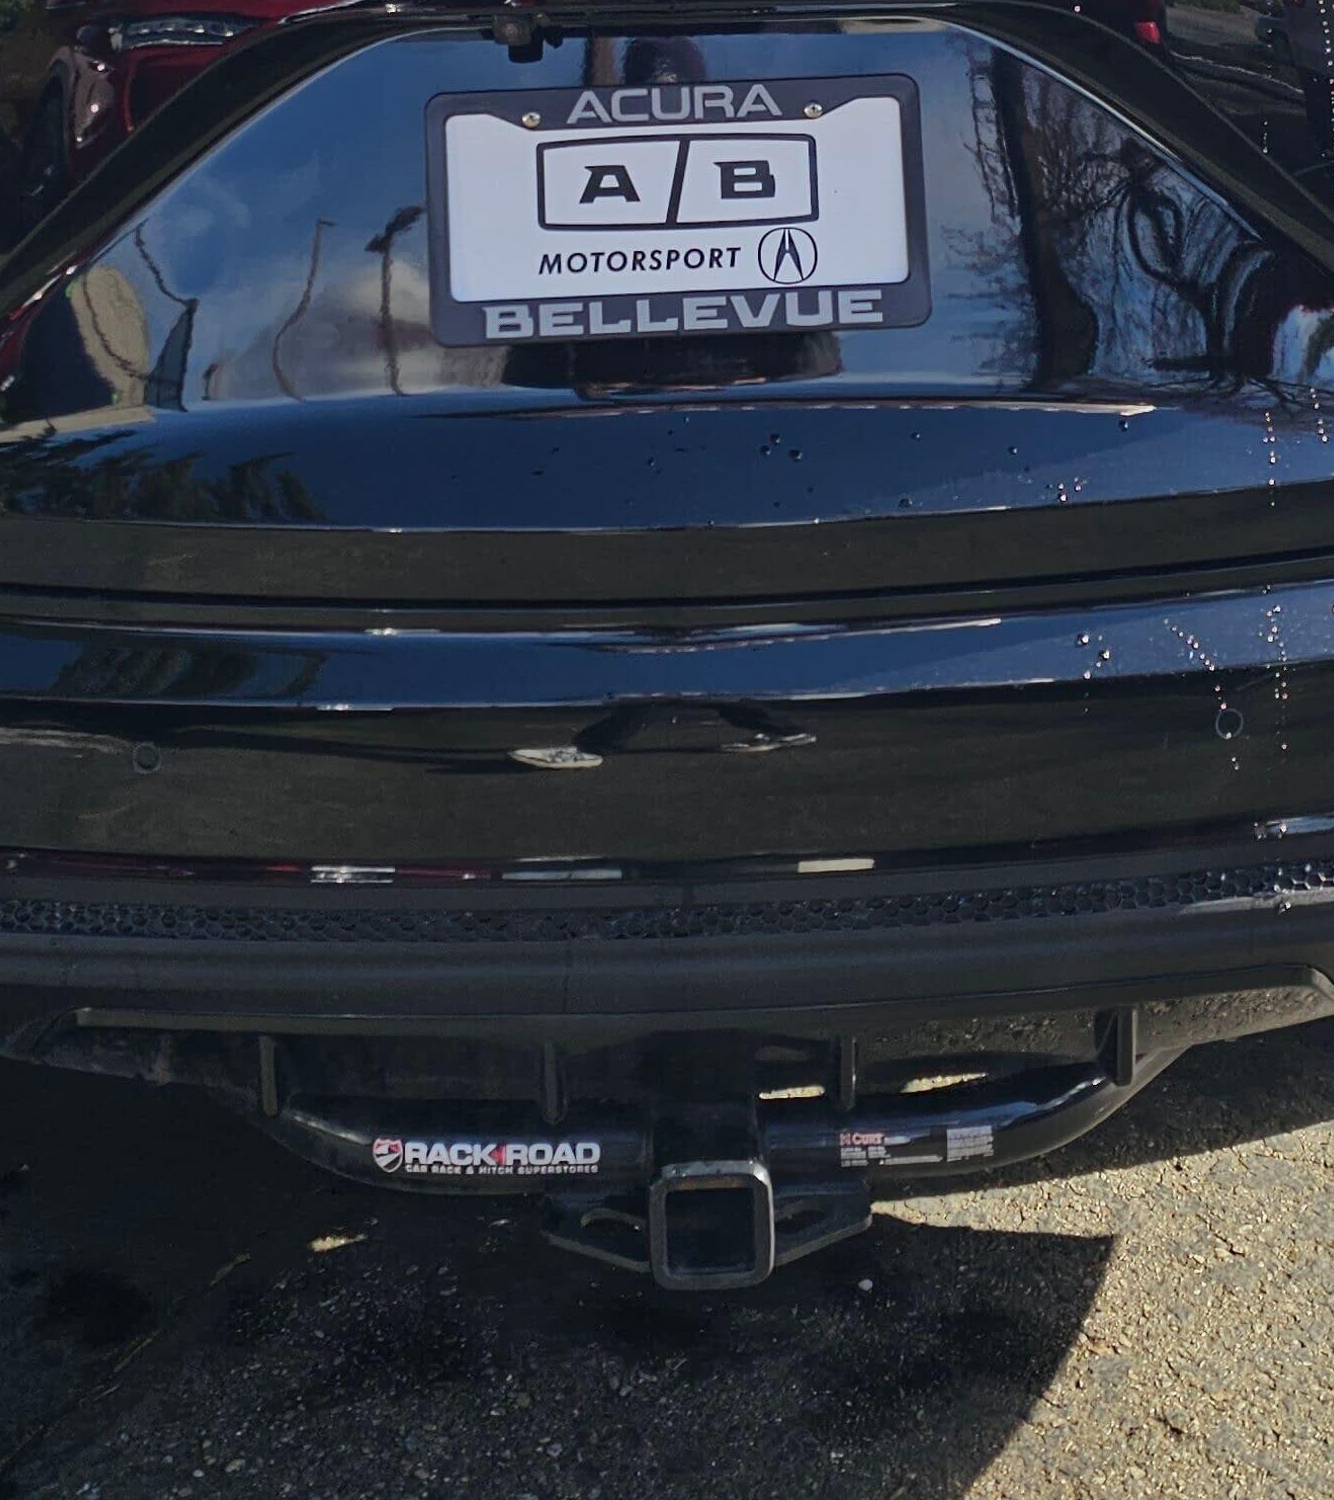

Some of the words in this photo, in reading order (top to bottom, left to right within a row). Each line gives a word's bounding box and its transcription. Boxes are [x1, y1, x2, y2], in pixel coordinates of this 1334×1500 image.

[566, 84, 783, 125] ACURA
[579, 164, 641, 204] A
[713, 160, 777, 200] B
[538, 246, 742, 276] MOTORSPORT
[482, 289, 884, 340] BELLEVUE
[404, 1141, 497, 1166] RACK
[505, 1142, 601, 1166] ROAD
[405, 1164, 428, 1173] CAR
[431, 1164, 462, 1175] RACK
[478, 1165, 514, 1175] HITCH
[517, 1164, 599, 1175] SUPERSTORES
